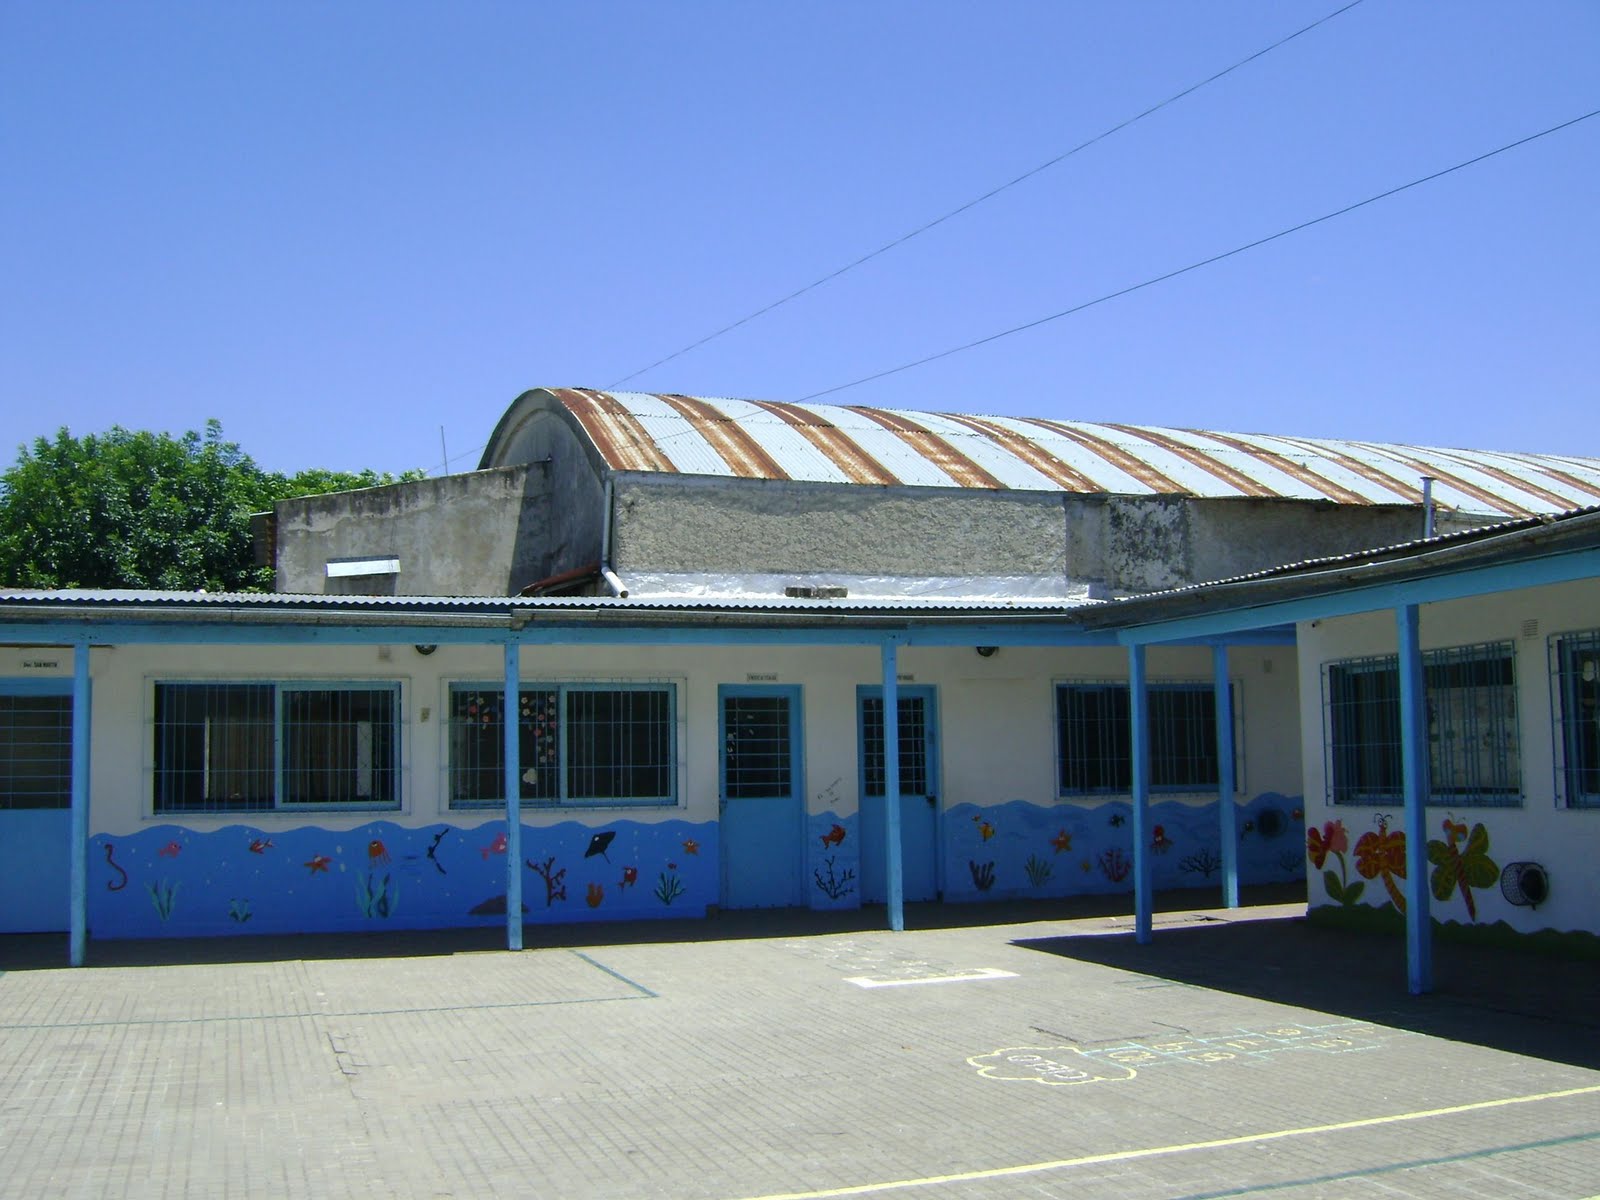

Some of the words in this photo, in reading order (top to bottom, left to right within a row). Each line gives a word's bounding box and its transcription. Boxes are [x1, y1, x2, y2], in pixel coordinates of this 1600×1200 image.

[1265, 1028, 1301, 1036] 6
[1152, 1041, 1194, 1051] 9
[1310, 1039, 1353, 1049] 5
[1108, 1050, 1157, 1062] 10
[1187, 1052, 1236, 1062] 8
[1006, 1054, 1088, 1079] CIELO
